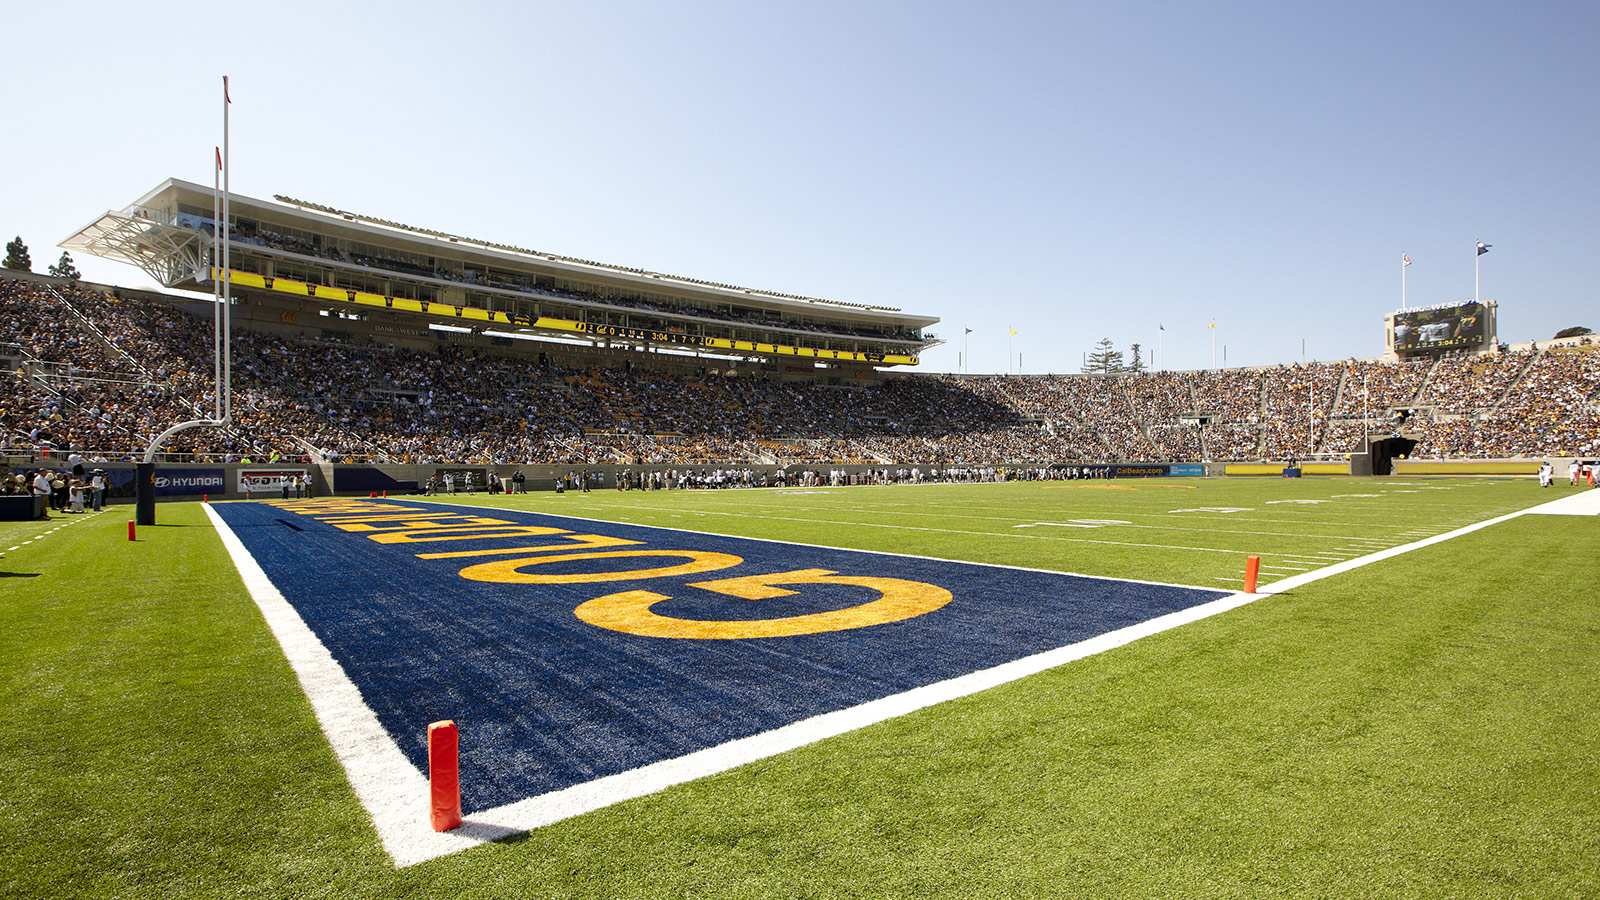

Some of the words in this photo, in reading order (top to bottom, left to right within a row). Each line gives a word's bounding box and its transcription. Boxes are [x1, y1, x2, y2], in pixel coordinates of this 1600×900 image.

[609, 327, 615, 335] 0
[651, 332, 668, 341] 3:04
[682, 335, 687, 343] 7
[1116, 467, 1163, 475] CalBears.com
[173, 477, 223, 486] HYUNDAI
